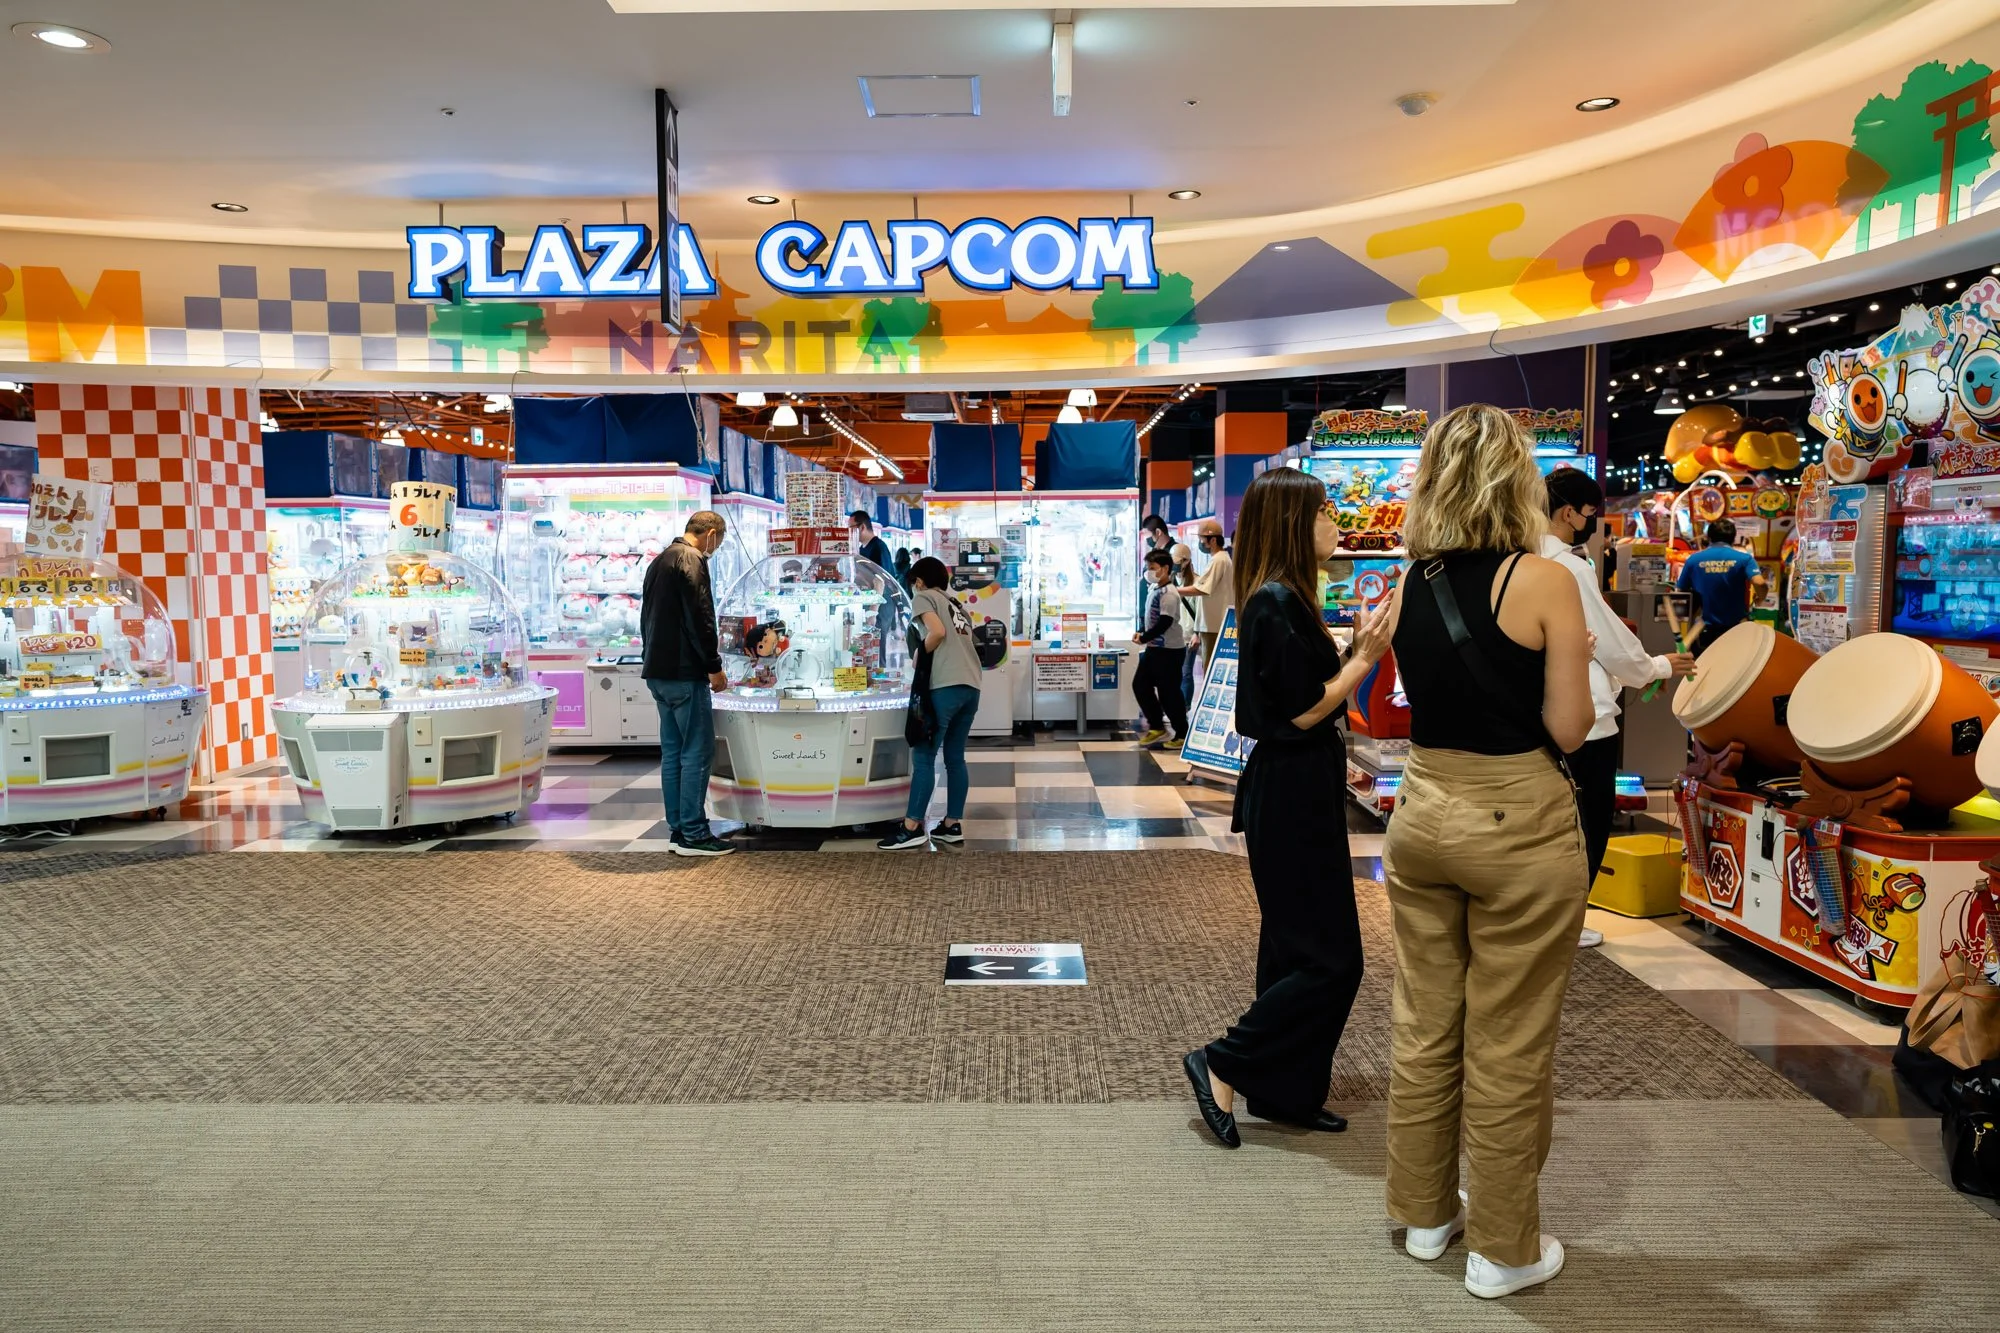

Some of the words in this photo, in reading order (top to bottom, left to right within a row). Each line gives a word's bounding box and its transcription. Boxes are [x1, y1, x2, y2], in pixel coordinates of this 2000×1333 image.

[407, 224, 717, 298] PLAZA
[755, 216, 1160, 296] CAPCOM
[608, 317, 910, 374] NARITA
[402, 486, 408, 498] 1
[413, 484, 441, 500] プレイ
[607, 480, 665, 494] TRIPLE
[35, 500, 78, 523] プレイ
[400, 503, 418, 527] 6
[412, 523, 441, 538] プレイ
[960, 540, 990, 554] 両替
[65, 634, 97, 650] ¥20
[772, 750, 796, 760] Sweet
[796, 749, 818, 760] Land
[819, 749, 826, 760] 5
[1028, 960, 1061, 976] 4
